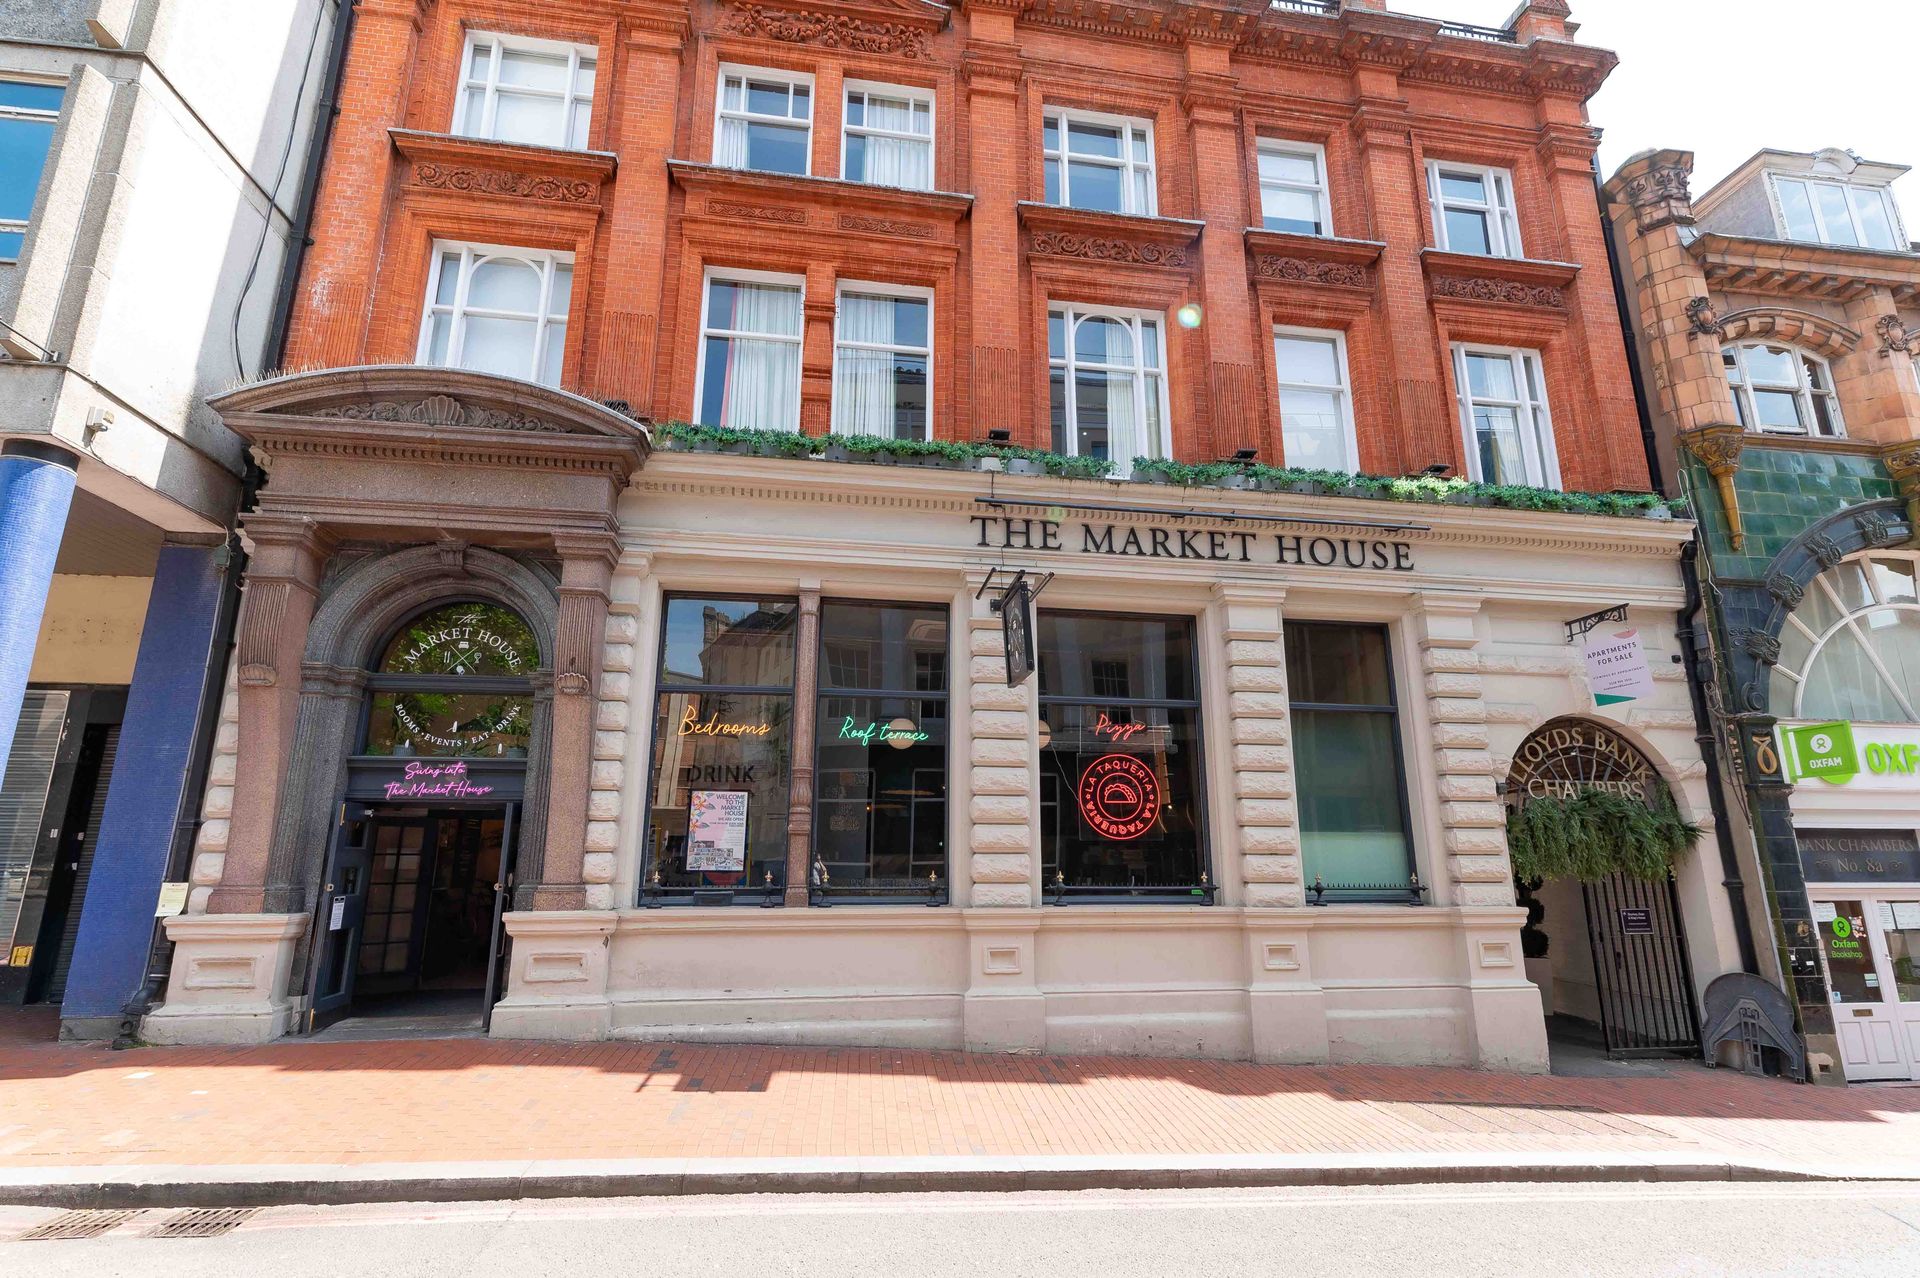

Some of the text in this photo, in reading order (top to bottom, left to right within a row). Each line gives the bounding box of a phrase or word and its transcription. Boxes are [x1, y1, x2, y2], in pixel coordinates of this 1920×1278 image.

[970, 515, 1415, 571] THE MARKET HOUSE
[404, 627, 522, 670] MARKET HOUSE
[1587, 641, 1637, 660] APARTMENTS
[1598, 652, 1633, 666] FOR SALE
[395, 703, 521, 747] ROOMS EVENTS EAT DRINK
[678, 704, 771, 735] Bedrooms
[1095, 713, 1145, 741] Pizza
[839, 716, 929, 746] Roof terrace
[1510, 727, 1654, 785] LLOYDS BANK
[1809, 757, 1842, 769] OXFAM
[405, 761, 467, 779] Swing into
[686, 765, 756, 783] DRINK
[1085, 760, 1153, 792] LA TAQUERIA
[384, 780, 493, 800] The Market House
[1086, 800, 1155, 835] LA TAQUERIA
[1838, 838, 1915, 852] CHAMBERS
[1837, 858, 1884, 872] No. 8a
[1831, 950, 1863, 959] Bookshop
[1832, 940, 1859, 949] Oxfam
